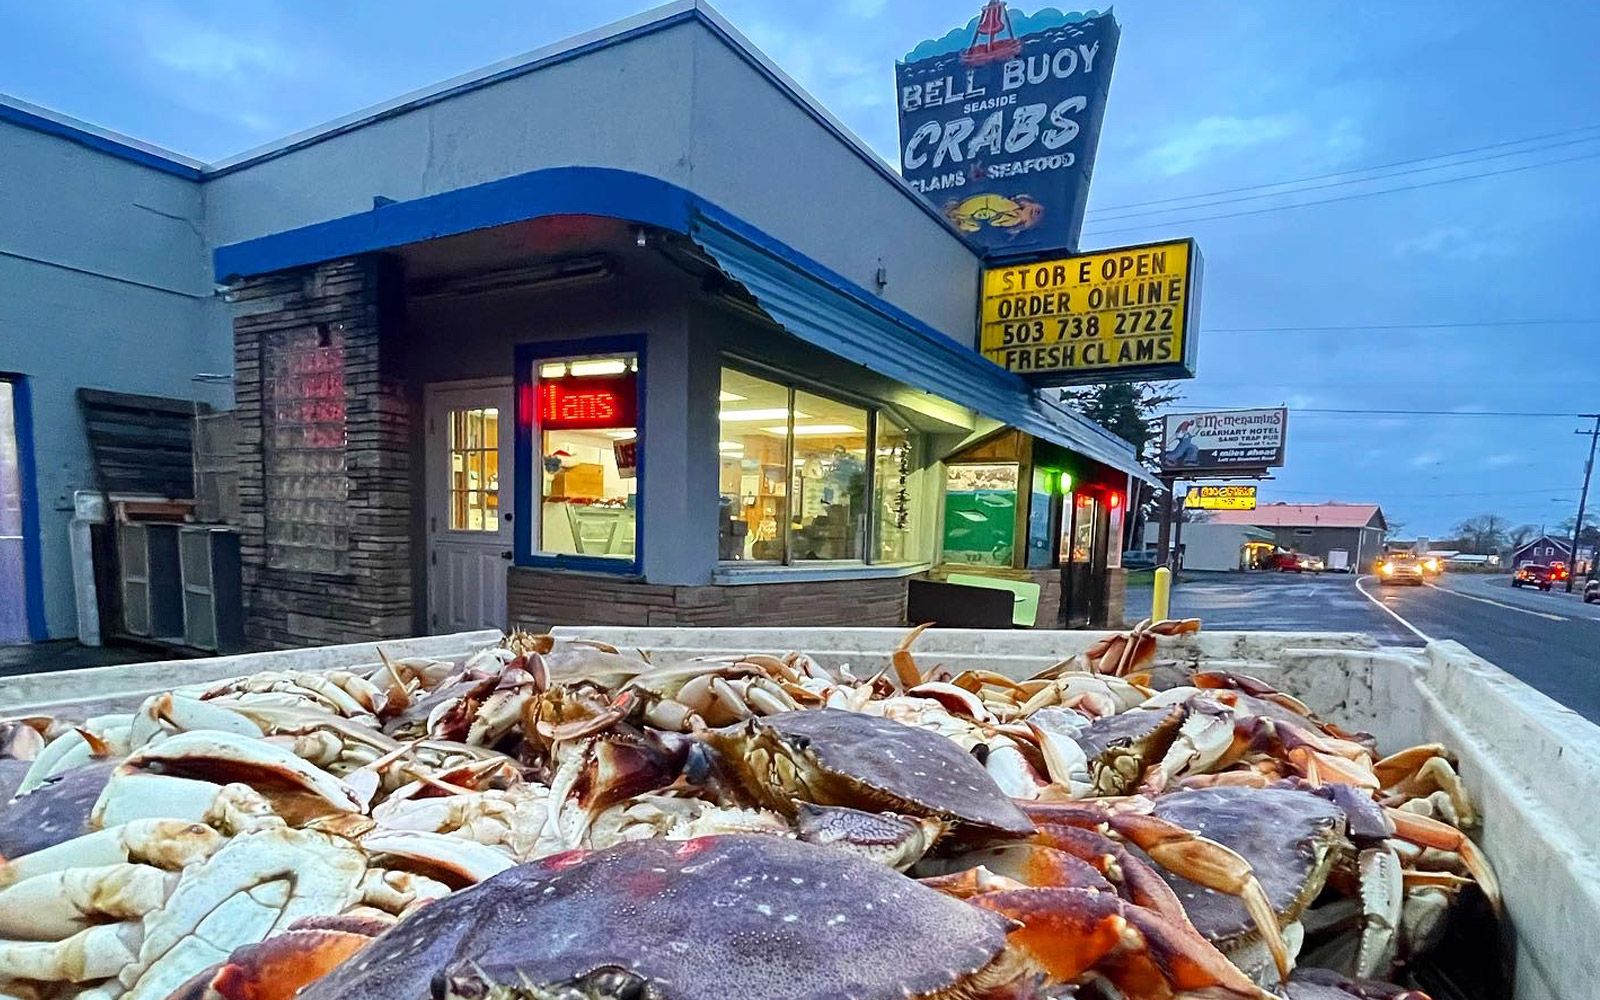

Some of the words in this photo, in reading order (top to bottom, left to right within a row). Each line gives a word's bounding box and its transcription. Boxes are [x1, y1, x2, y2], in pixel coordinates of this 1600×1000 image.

[902, 70, 986, 112] BELL
[1002, 40, 1099, 91] BUOY
[963, 94, 1017, 114] SEASIDE
[904, 96, 1087, 169] CRABS
[987, 152, 1075, 179] SEAFOOD
[1101, 252, 1167, 280] OPEN
[998, 291, 1071, 318] ORDER
[1088, 279, 1182, 309] ONLINE
[1003, 321, 1044, 345] 503
[1057, 315, 1099, 340] 738
[1114, 308, 1173, 335] 2722
[1005, 345, 1075, 371] FRESH
[1200, 428, 1247, 437] GEARHART
[1250, 427, 1279, 435] HOTEL
[1211, 449, 1218, 457] 4
[1220, 449, 1245, 457] miles
[1247, 448, 1276, 456] ahead
